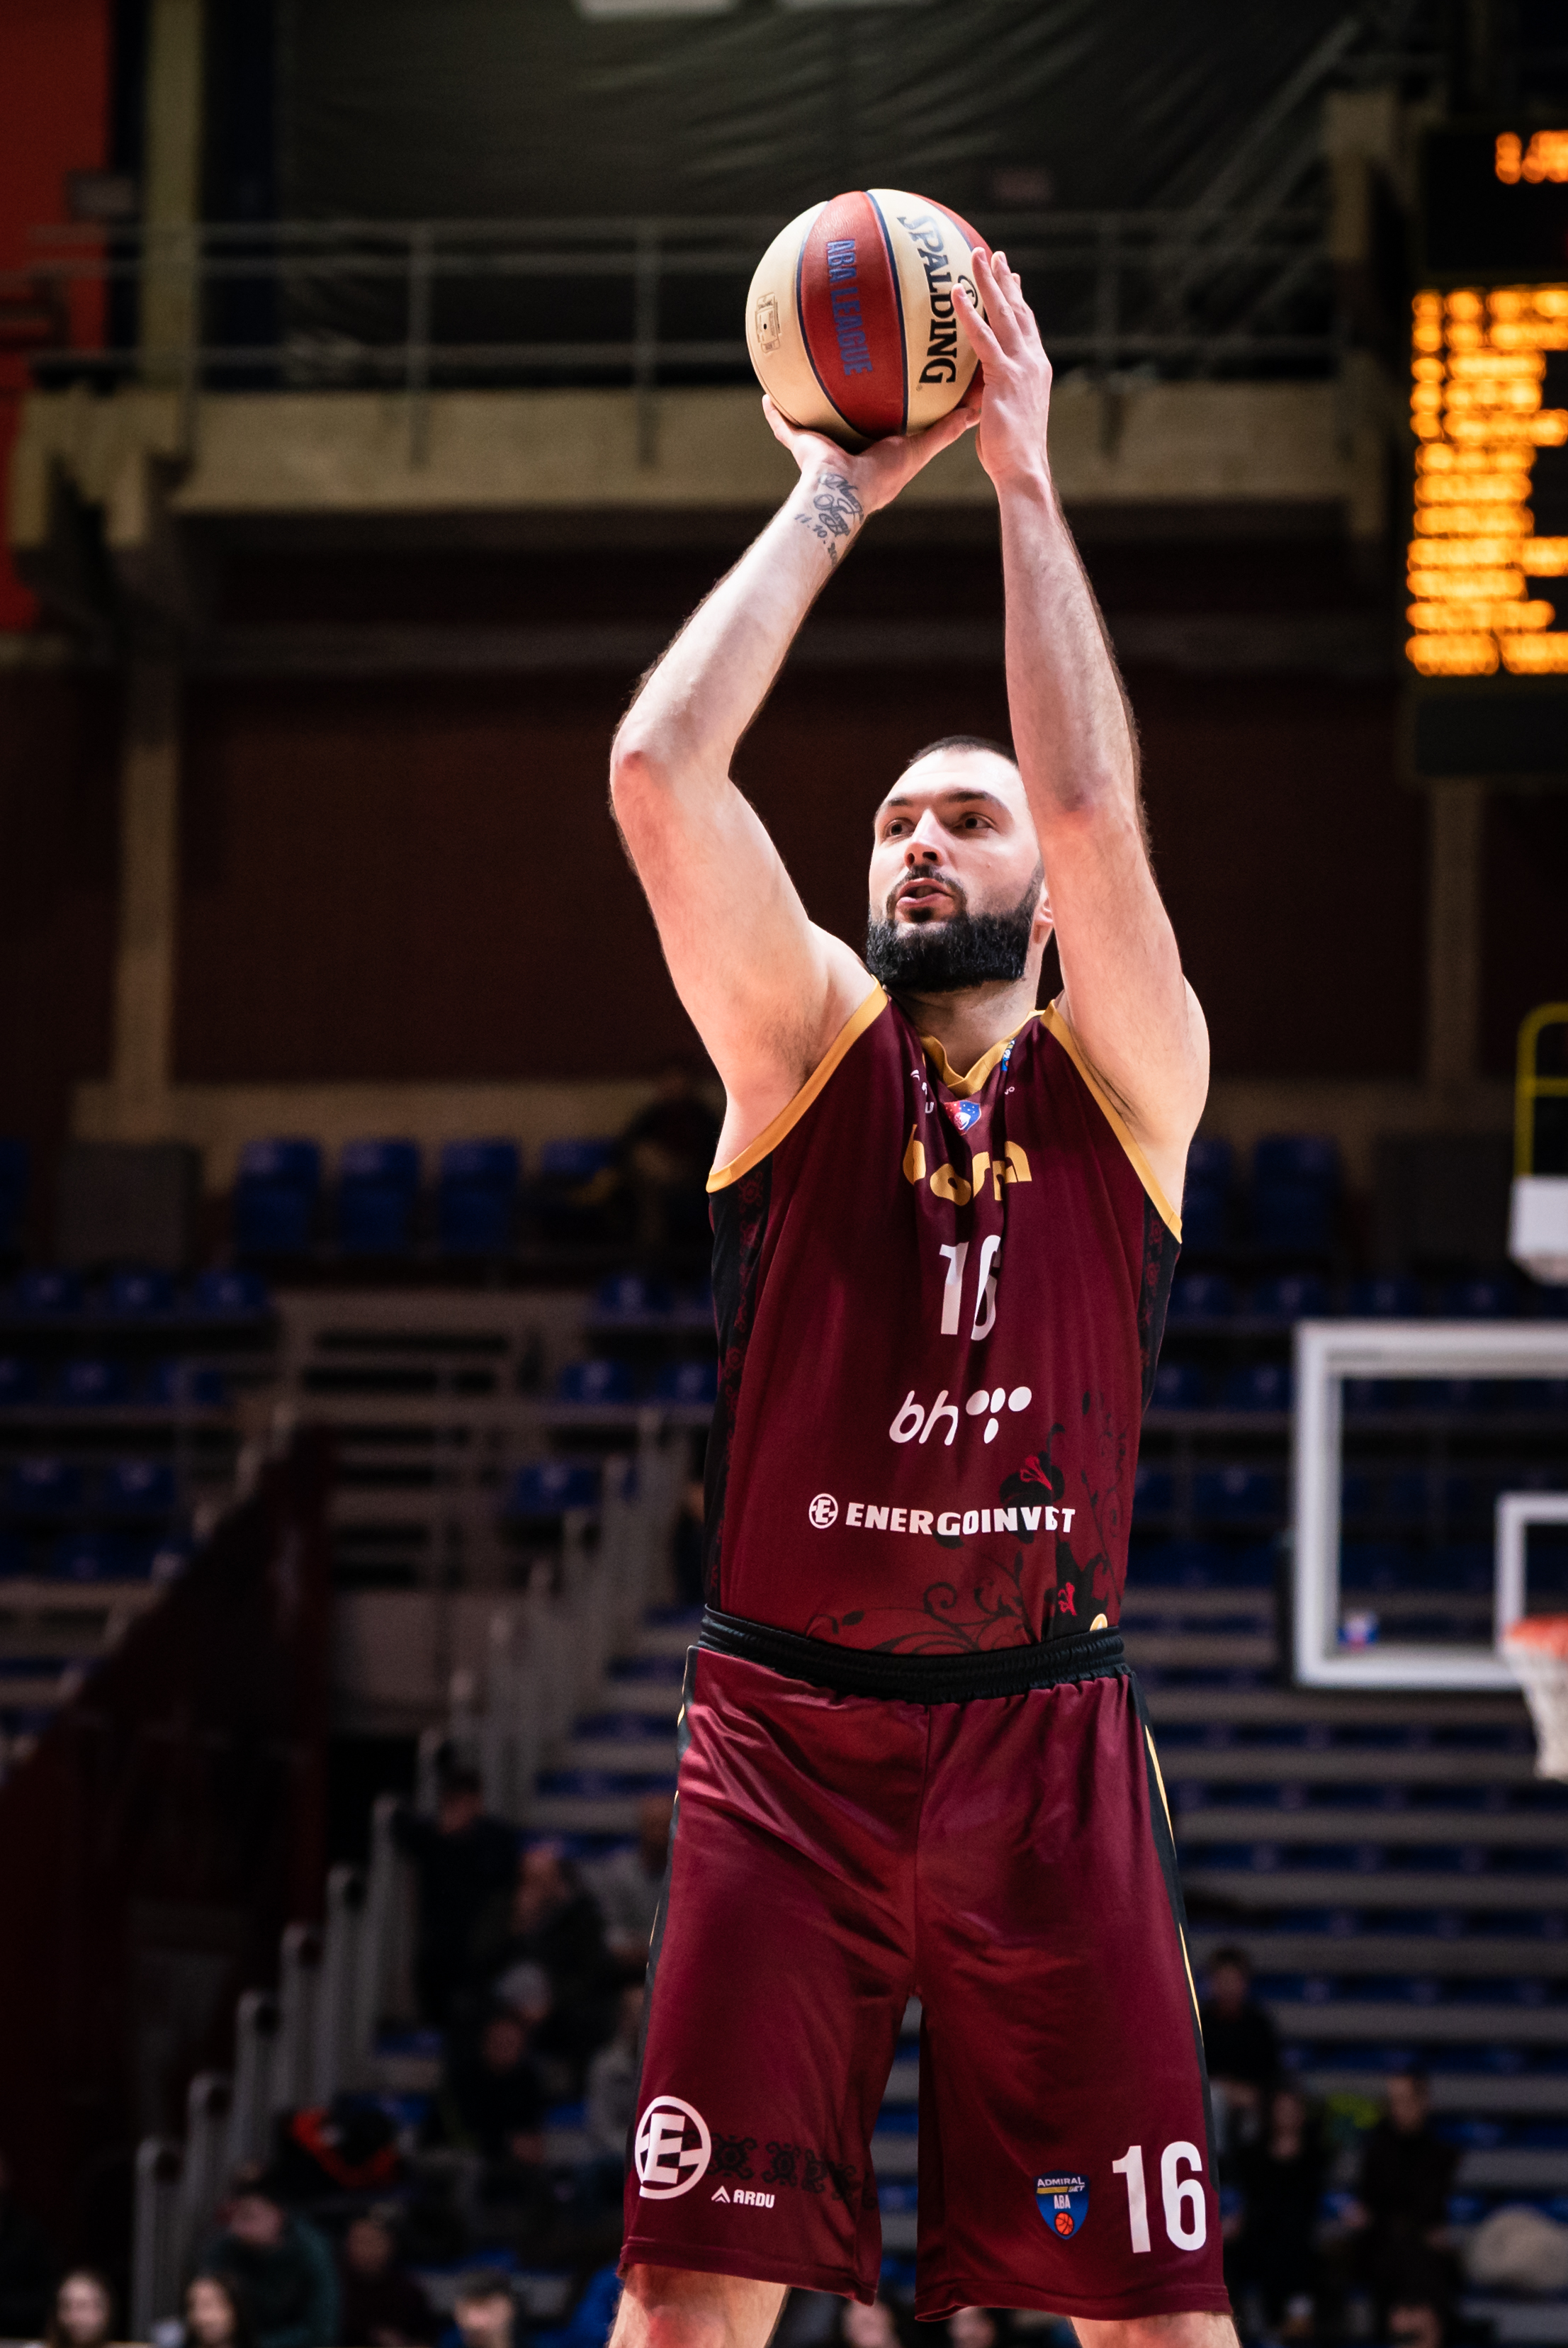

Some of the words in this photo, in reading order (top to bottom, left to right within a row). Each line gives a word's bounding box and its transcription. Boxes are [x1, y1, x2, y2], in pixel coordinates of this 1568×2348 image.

[826, 238, 857, 284] ABA
[830, 287, 874, 376] LEAGUE
[896, 215, 957, 385] SPALDING
[939, 1235, 1001, 1341] 16
[733, 2189, 775, 2208] ARDU
[1037, 2176, 1085, 2187] ADMIRAL
[1054, 2194, 1071, 2210] ABA
[1112, 2140, 1207, 2253] 16
